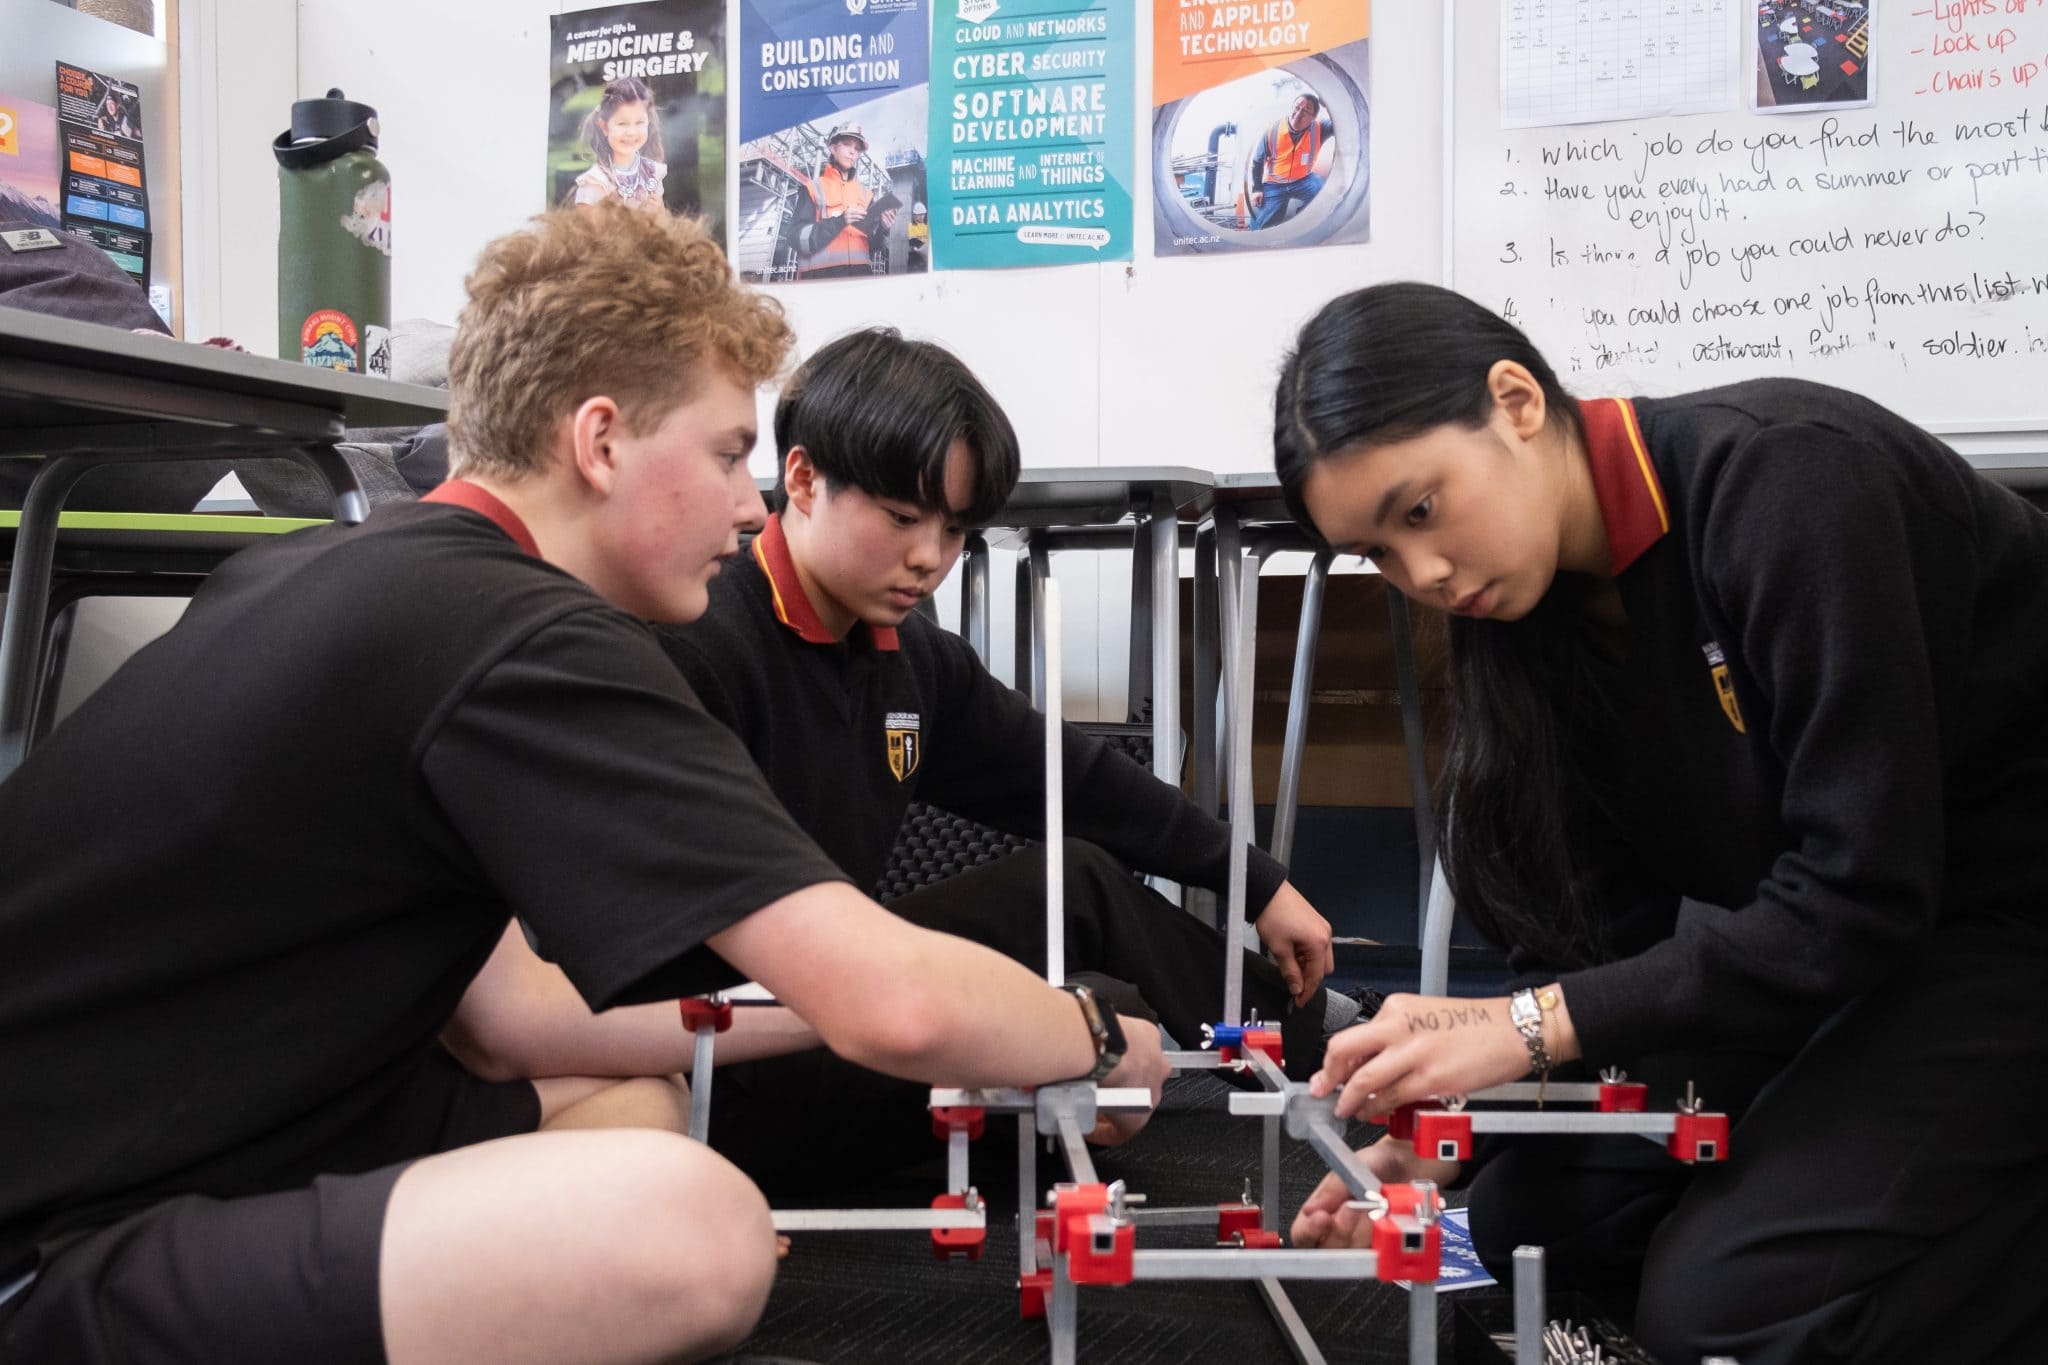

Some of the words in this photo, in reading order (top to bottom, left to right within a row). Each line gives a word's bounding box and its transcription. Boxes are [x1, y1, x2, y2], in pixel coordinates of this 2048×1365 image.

[574, 28, 600, 39] career
[599, 26, 612, 38] for
[612, 23, 626, 35] life
[626, 22, 636, 33] in
[956, 24, 1001, 43] CLOUD
[1006, 23, 1025, 40] AND
[1028, 16, 1107, 37] NETWORKS
[1180, 9, 1205, 32] AND
[1212, 0, 1295, 29] APPLIED
[566, 32, 674, 63] MEDICINE
[676, 30, 694, 51] &
[762, 33, 862, 68] BUILDING
[870, 32, 894, 56] AND
[1180, 21, 1311, 56] TECHNOLOGY
[603, 52, 709, 81] SURGERY
[762, 59, 900, 91] CONSTRUCTION
[953, 51, 1025, 80] CYBER
[1032, 50, 1106, 71] SECURITY
[953, 84, 1106, 120] SOFTWARE
[953, 113, 1106, 144] DEVELOPMENT
[1040, 152, 1093, 166] INTERNET
[1632, 132, 1683, 184] job
[1696, 129, 1733, 155] do
[1744, 132, 1803, 174] you
[1810, 117, 1880, 167] find
[1893, 120, 1939, 149] the
[1955, 108, 2031, 141] most
[951, 156, 1016, 175] MACHINE
[1018, 164, 1037, 181] AND
[951, 174, 1015, 191] LEARNING
[1544, 177, 1595, 200] Have
[1605, 183, 1647, 220] you
[1658, 177, 1710, 221] every
[1719, 170, 1776, 193] had
[1786, 180, 1804, 192] a
[1815, 168, 1912, 190] summer
[1927, 165, 1954, 181] or
[1966, 150, 2027, 205] part
[952, 205, 1000, 226] DATA
[1006, 199, 1105, 223] ANALYTICS
[1629, 202, 1697, 249] enjoy
[1173, 235, 1221, 246] unitec.ac.nz
[1500, 241, 1522, 264] 3.
[1550, 237, 1569, 268] Is
[1655, 247, 1671, 265] a
[1679, 240, 1720, 290] job
[1731, 244, 1780, 282] you
[1789, 227, 1854, 256] could
[1865, 229, 1929, 249] never
[1628, 300, 1681, 326] could
[1692, 299, 1766, 323] choose
[1774, 292, 1813, 315] one
[1820, 284, 1859, 333] job
[1864, 277, 1916, 324] from
[1917, 283, 1968, 305] this
